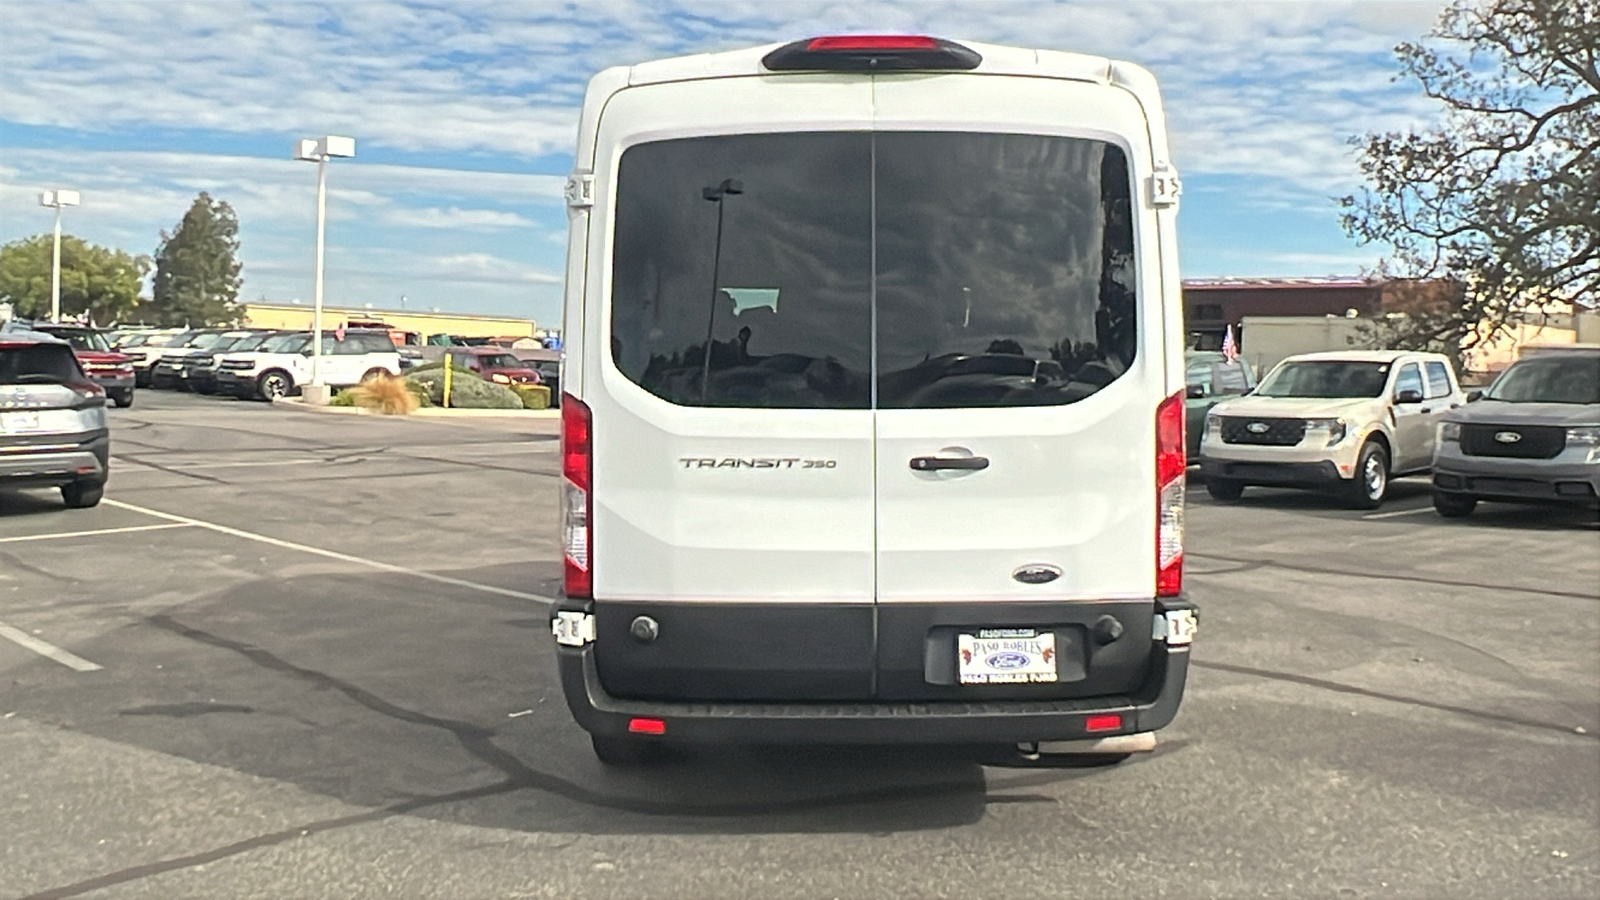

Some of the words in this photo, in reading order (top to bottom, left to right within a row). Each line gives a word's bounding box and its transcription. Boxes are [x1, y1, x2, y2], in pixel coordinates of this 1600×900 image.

[679, 458, 801, 469] TRANSIT
[802, 460, 837, 469] 350
[973, 641, 999, 656] PASO
[1003, 640, 1042, 656] ROBLES
